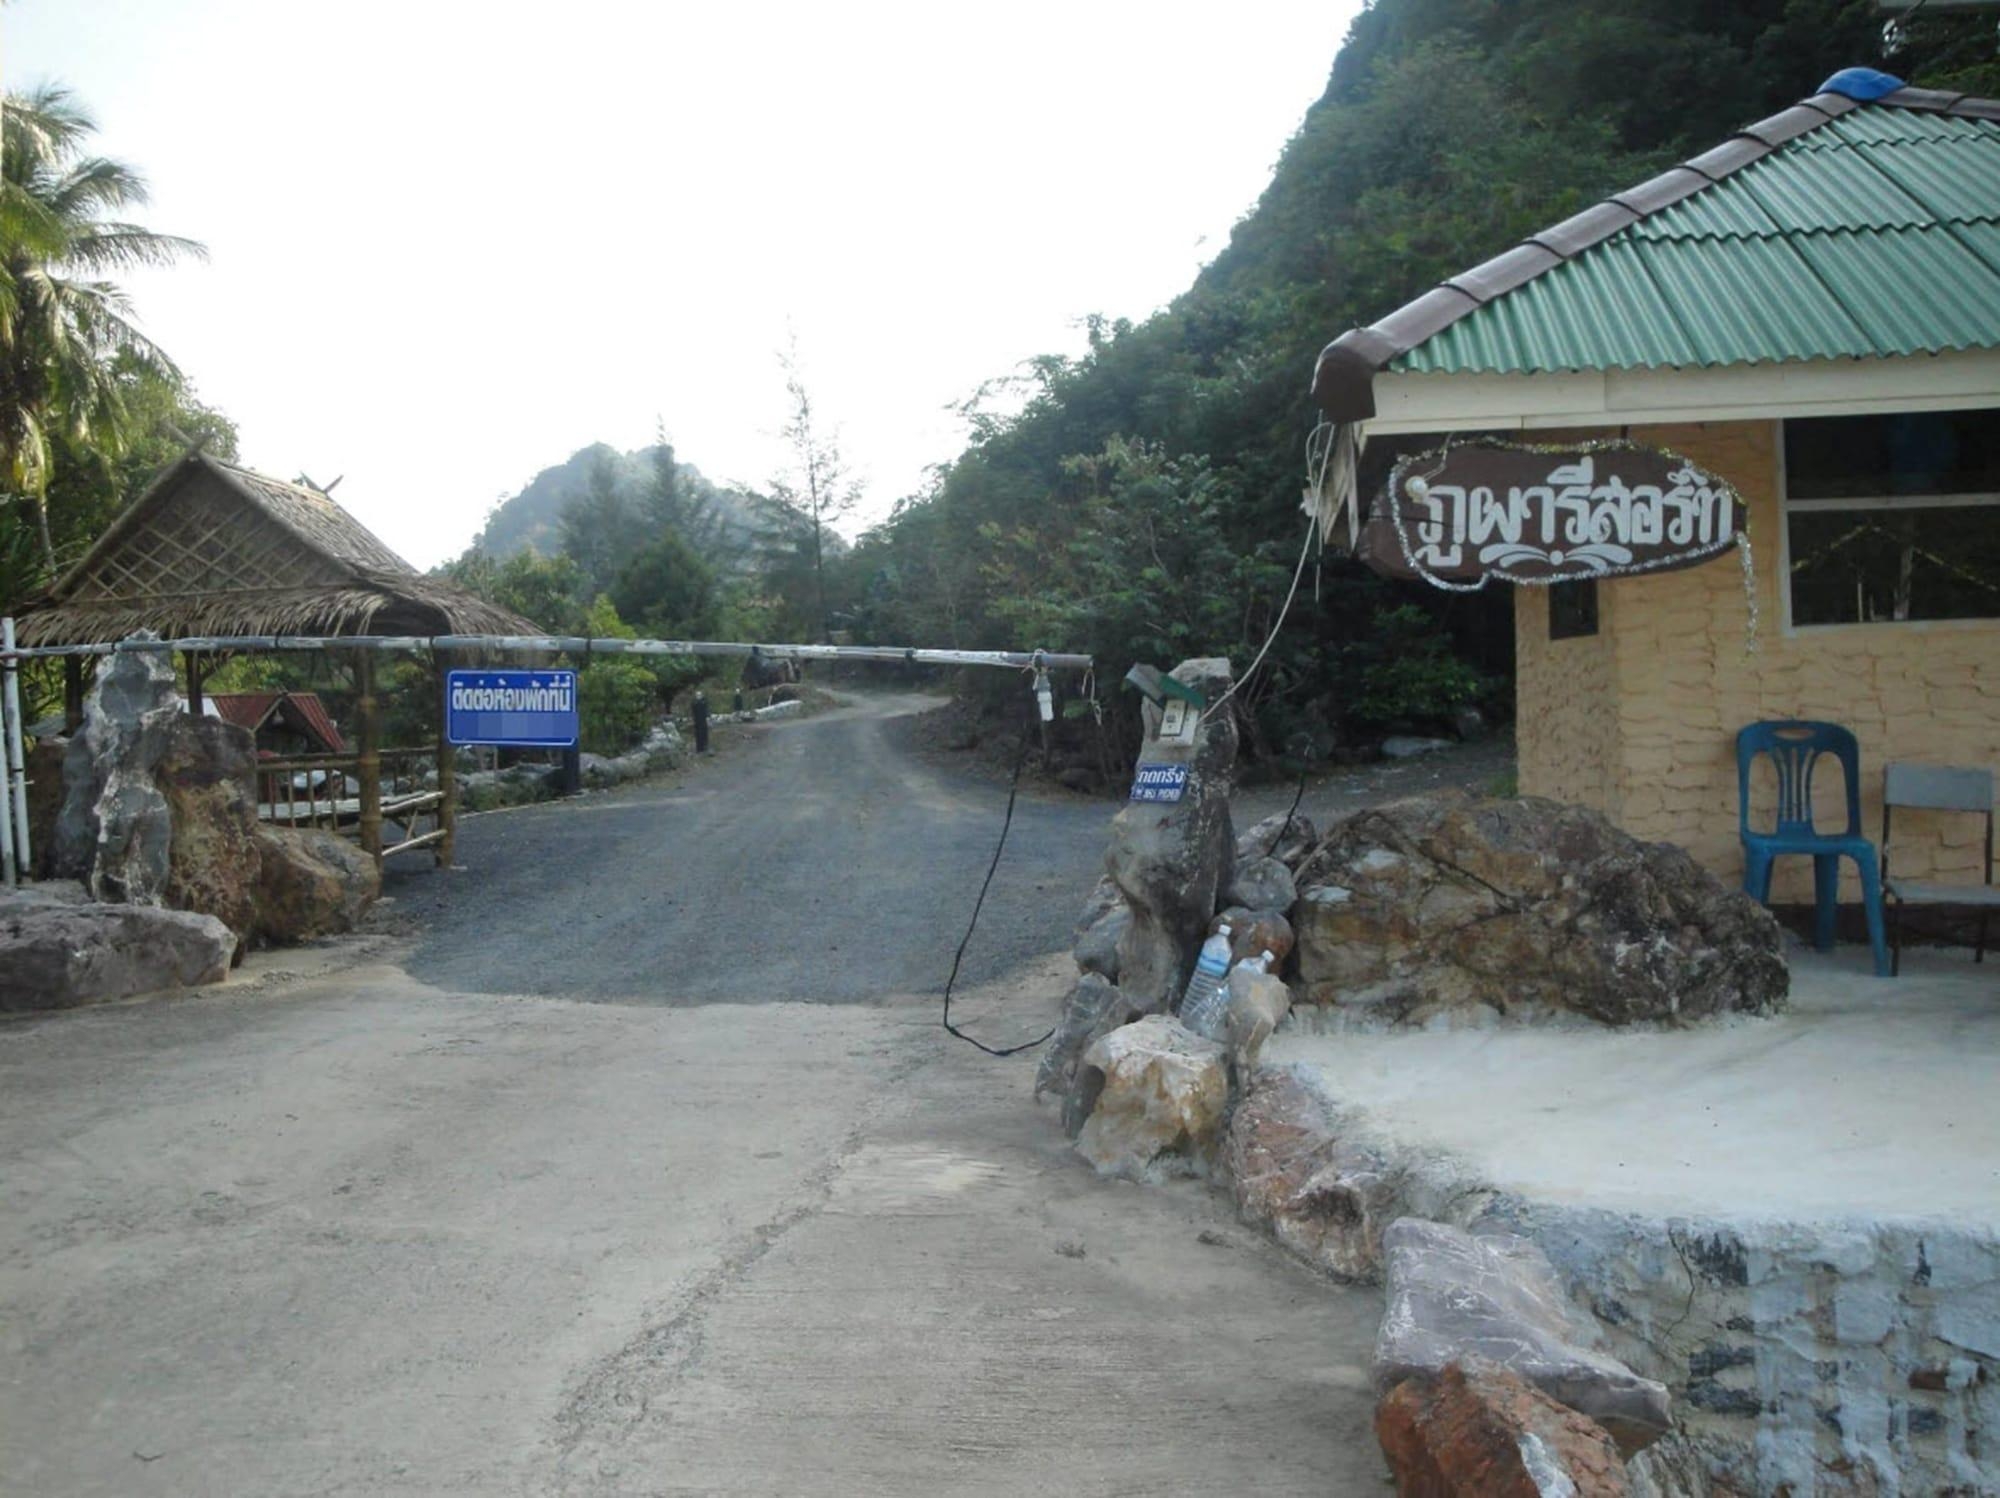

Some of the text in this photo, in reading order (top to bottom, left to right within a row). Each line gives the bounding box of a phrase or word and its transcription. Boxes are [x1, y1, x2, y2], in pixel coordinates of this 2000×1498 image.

[1415, 456, 1733, 567] ภูผารีสอร์ท
[452, 675, 571, 711] ติดต่อห้องพักที่นี่
